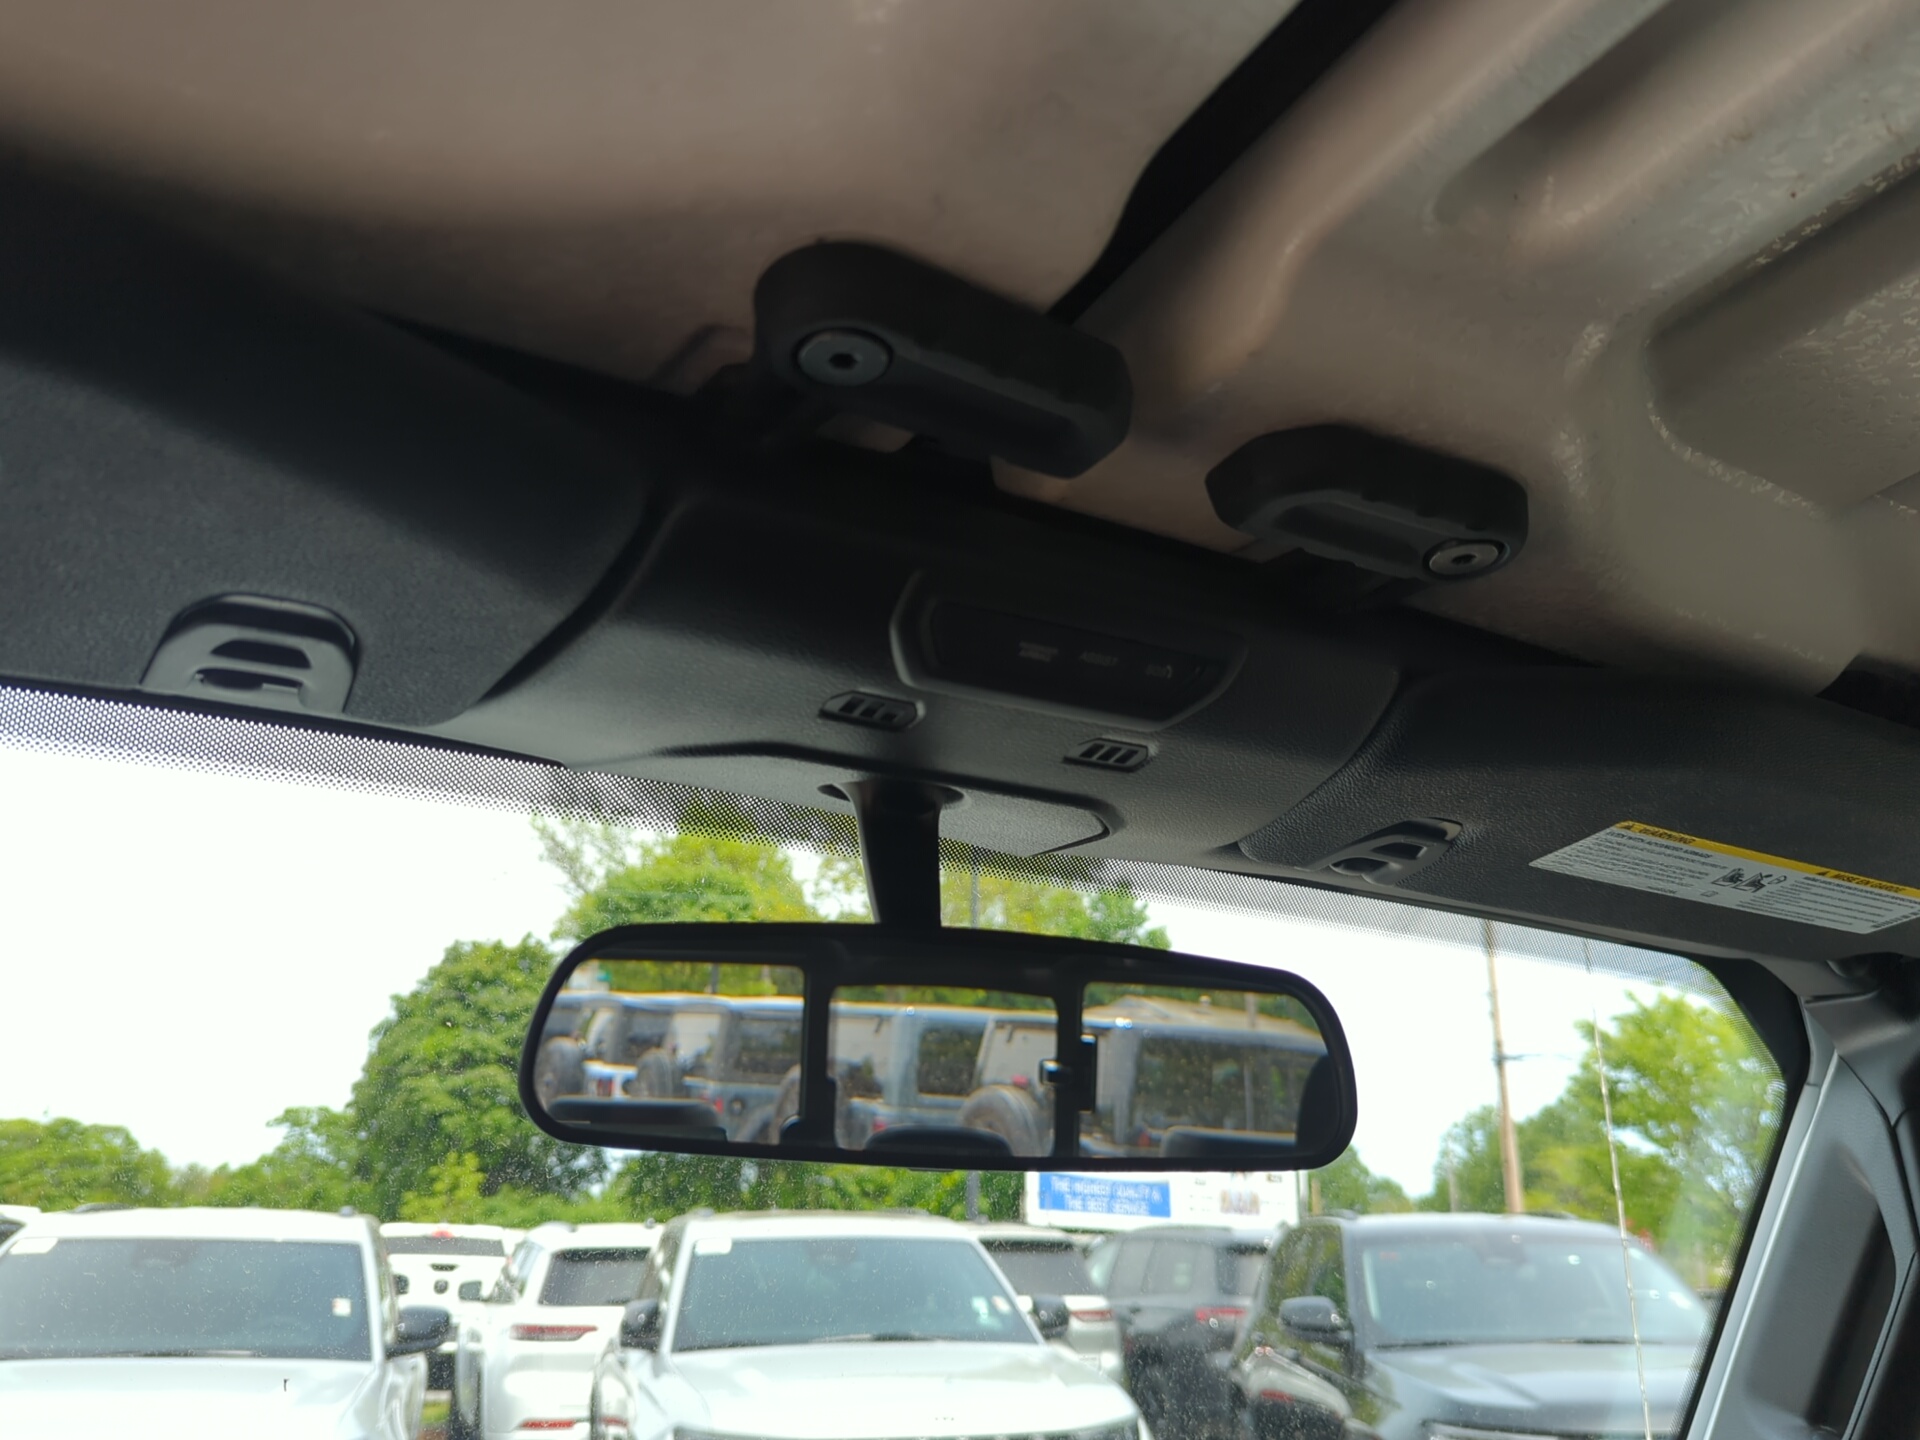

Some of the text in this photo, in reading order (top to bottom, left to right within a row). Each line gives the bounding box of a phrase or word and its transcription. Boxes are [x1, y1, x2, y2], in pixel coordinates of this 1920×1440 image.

[1638, 827, 1697, 845] WARNING
[1830, 873, 1907, 893] MISE EN GARDE
[1051, 1176, 1071, 1193] THE
[1066, 1195, 1083, 1210] THE
